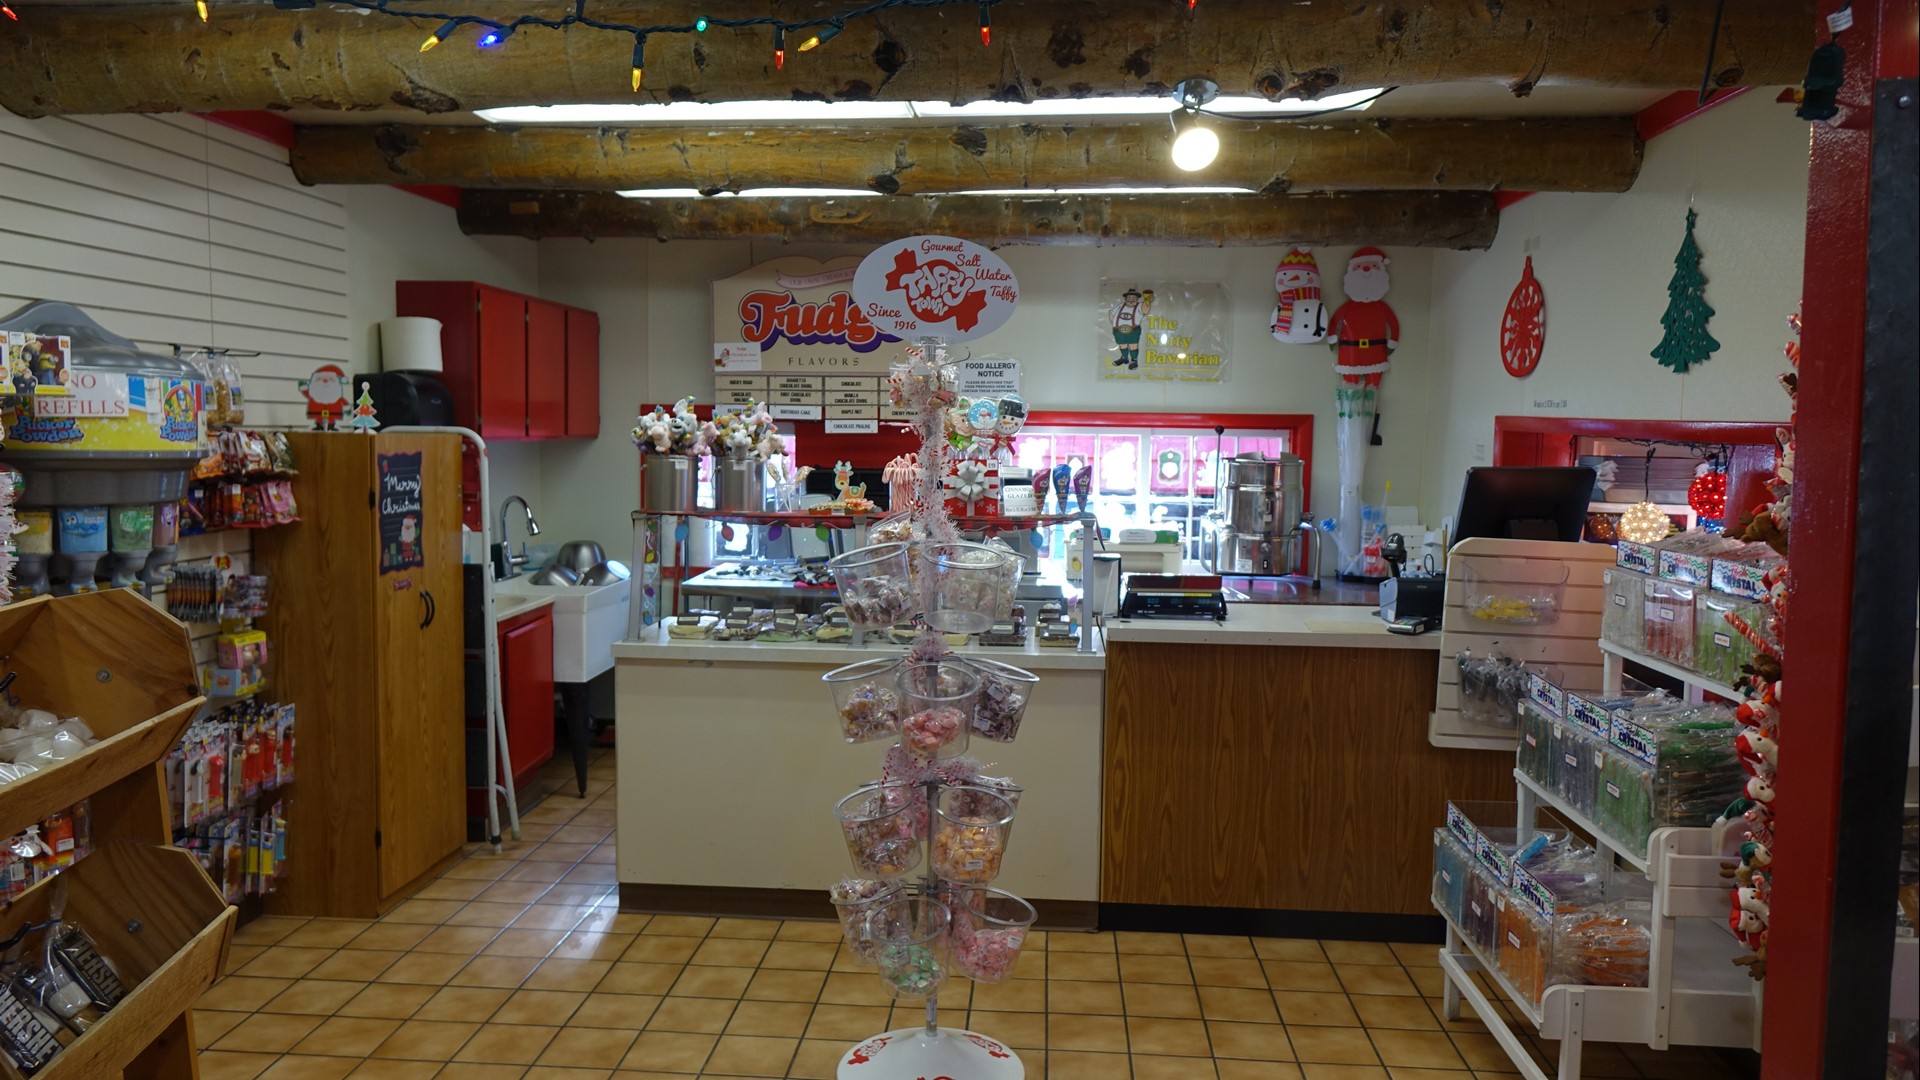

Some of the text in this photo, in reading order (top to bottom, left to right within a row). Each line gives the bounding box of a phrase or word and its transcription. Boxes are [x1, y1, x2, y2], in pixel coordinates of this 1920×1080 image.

[921, 239, 1017, 303] Gourmet Salt Water Taffy
[900, 265, 975, 306] TAFFY
[867, 302, 916, 330] Since 1916
[911, 296, 948, 316] TOWN
[739, 289, 882, 345] Fudg
[1147, 316, 1178, 330] The
[1146, 333, 1192, 351] Ntty
[788, 357, 860, 366] FLAVORS
[1146, 350, 1219, 366] Bavarian
[71, 374, 96, 388] NO
[37, 400, 125, 415] REFILLS
[384, 473, 421, 498] Merry
[382, 496, 421, 514] Christmas
[1624, 553, 1647, 567] CRYSTAL
[1722, 574, 1757, 594] CRYSTAL
[1537, 688, 1556, 708] CRYSTAL
[1574, 708, 1601, 730] CRYSTAL
[1618, 731, 1648, 754] CRYSTAL
[1520, 881, 1545, 912] CRYSTAL
